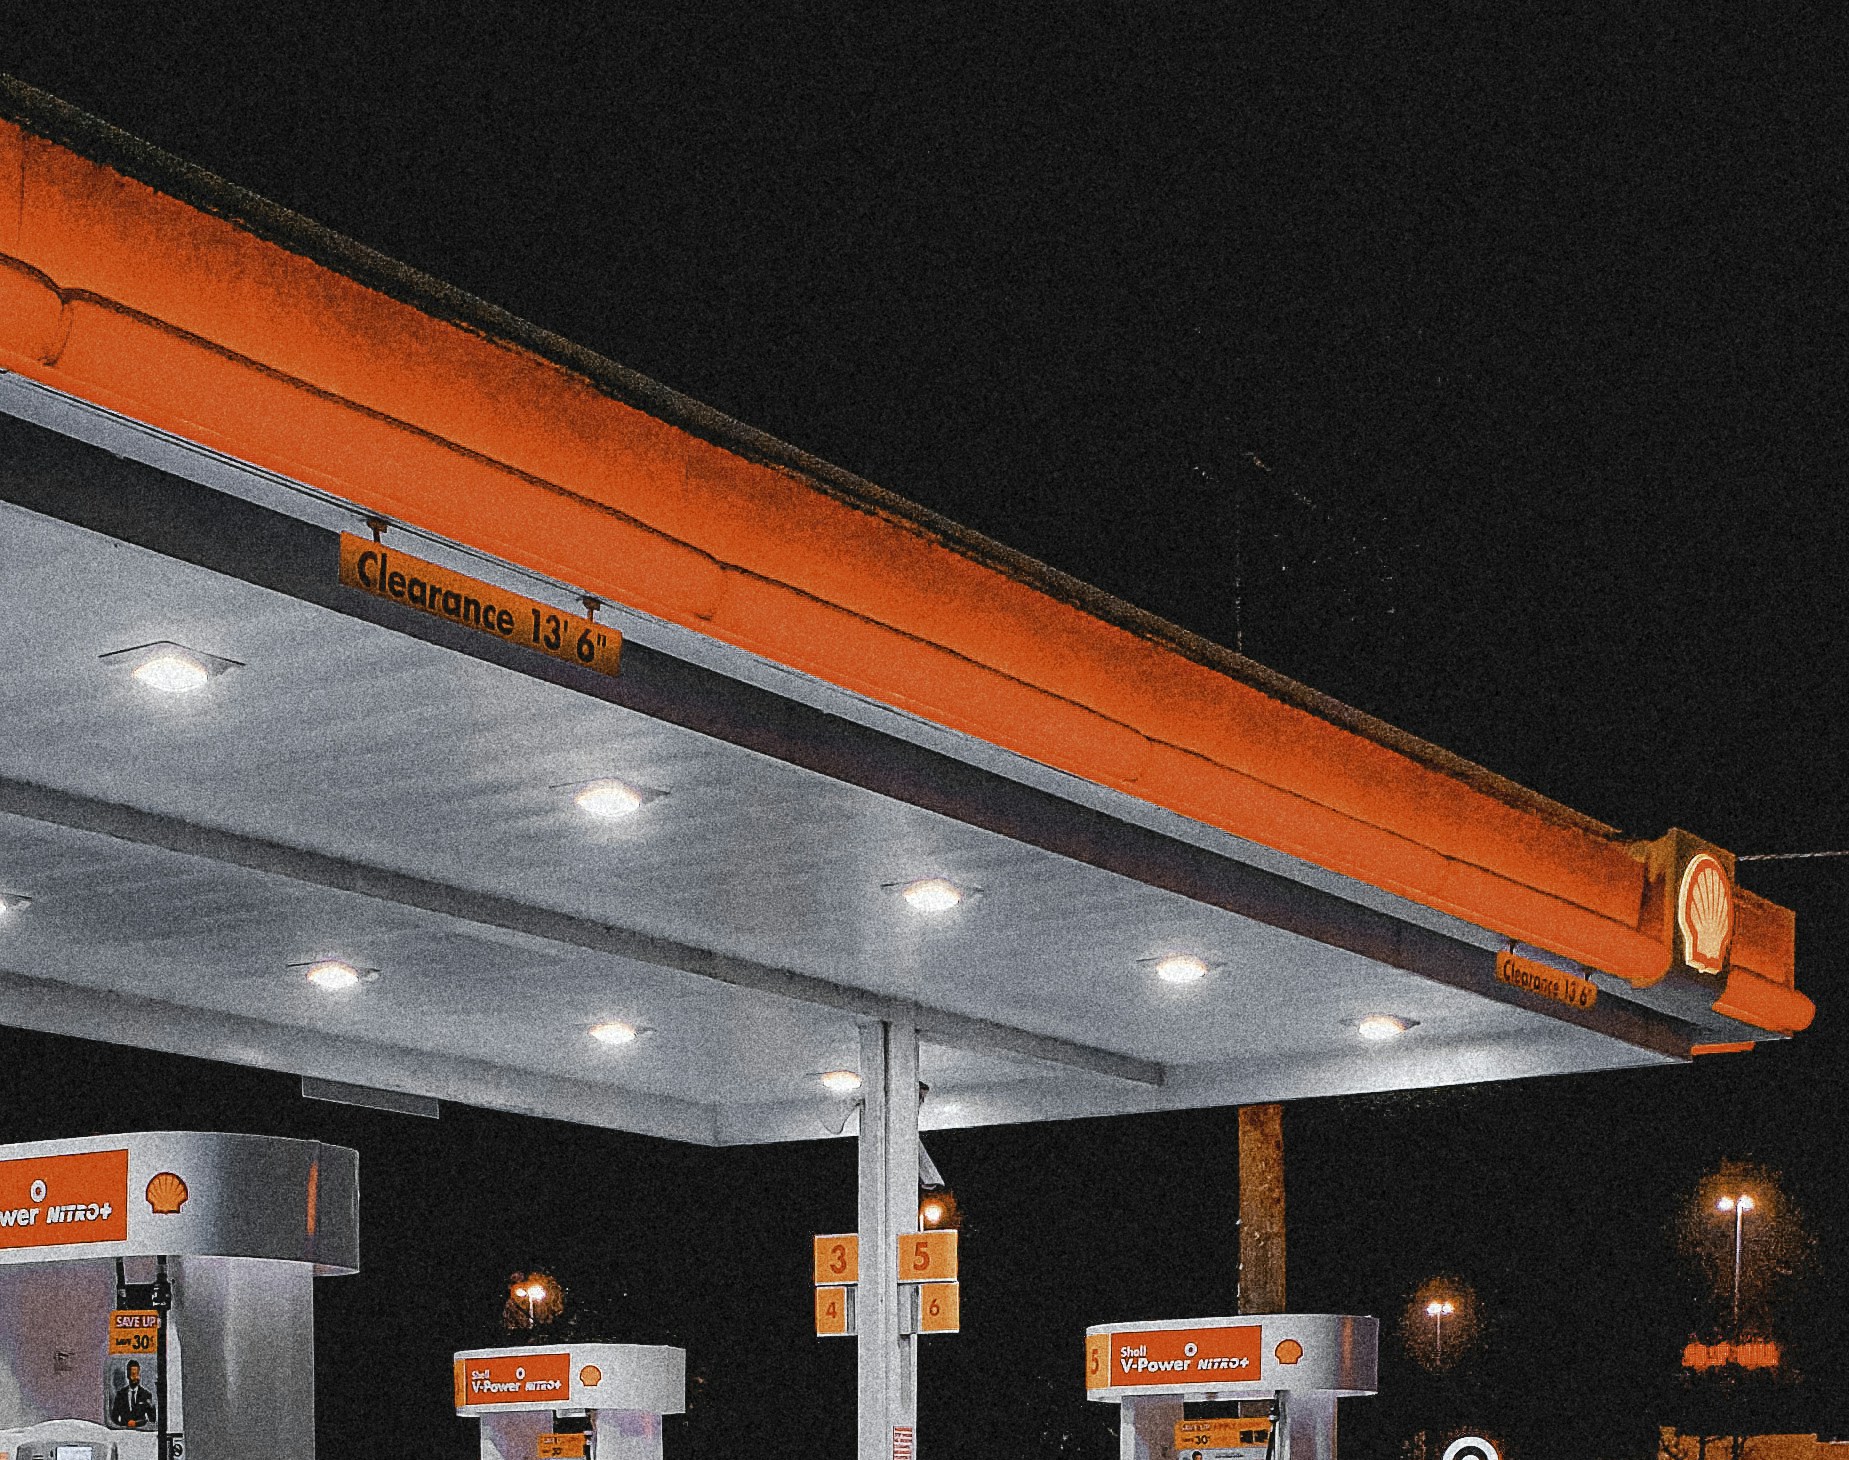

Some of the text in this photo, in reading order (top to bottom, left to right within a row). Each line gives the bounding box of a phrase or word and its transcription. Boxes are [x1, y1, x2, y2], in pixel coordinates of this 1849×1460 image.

[357, 550, 515, 636] Clearance
[531, 608, 568, 650] 13'
[1503, 959, 1559, 996] Clearance
[830, 1244, 848, 1274] 3
[912, 1241, 931, 1272] 5
[825, 1301, 838, 1319] 4
[929, 1299, 940, 1317] 6
[116, 1316, 140, 1328] SAVE
[1120, 1357, 1191, 1374] V-Power
[471, 1380, 521, 1393] V-Power
